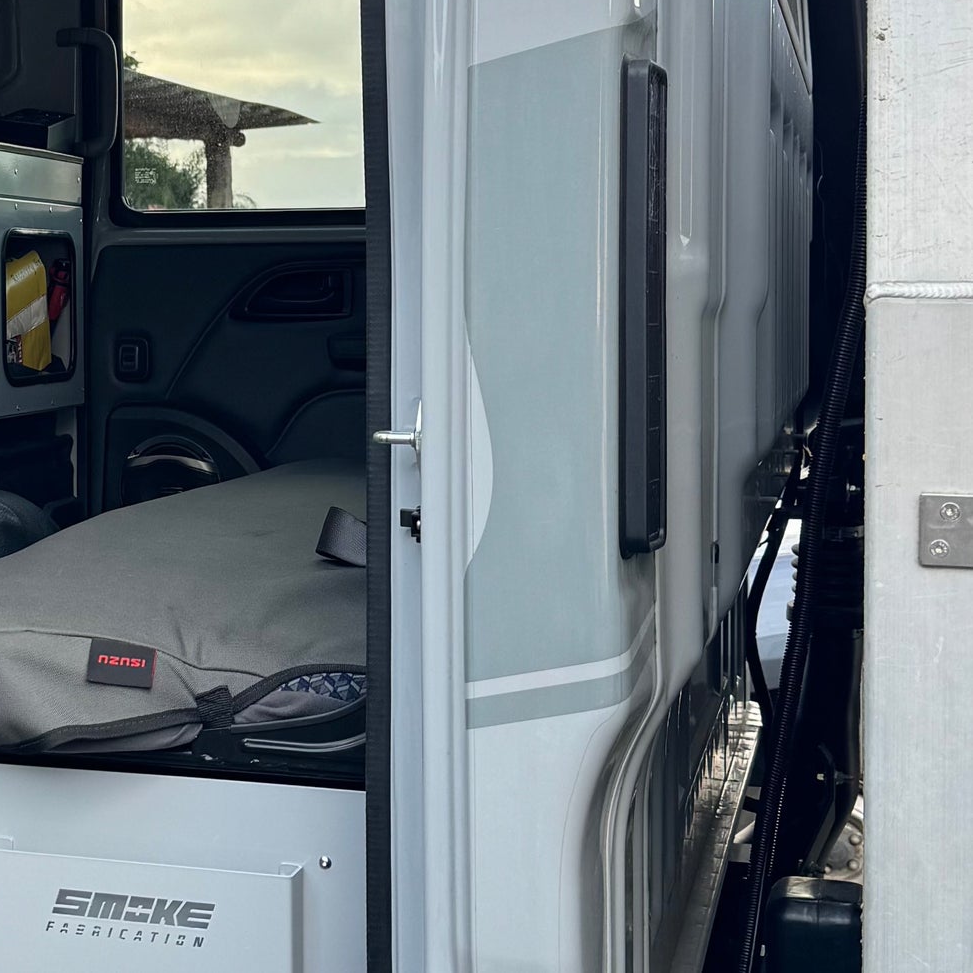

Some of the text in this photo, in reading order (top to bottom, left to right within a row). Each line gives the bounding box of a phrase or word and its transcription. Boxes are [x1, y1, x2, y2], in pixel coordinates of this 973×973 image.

[97, 654, 146, 668] ISUZU
[52, 888, 216, 930] SMOKE
[45, 920, 205, 948] FABRICATION
